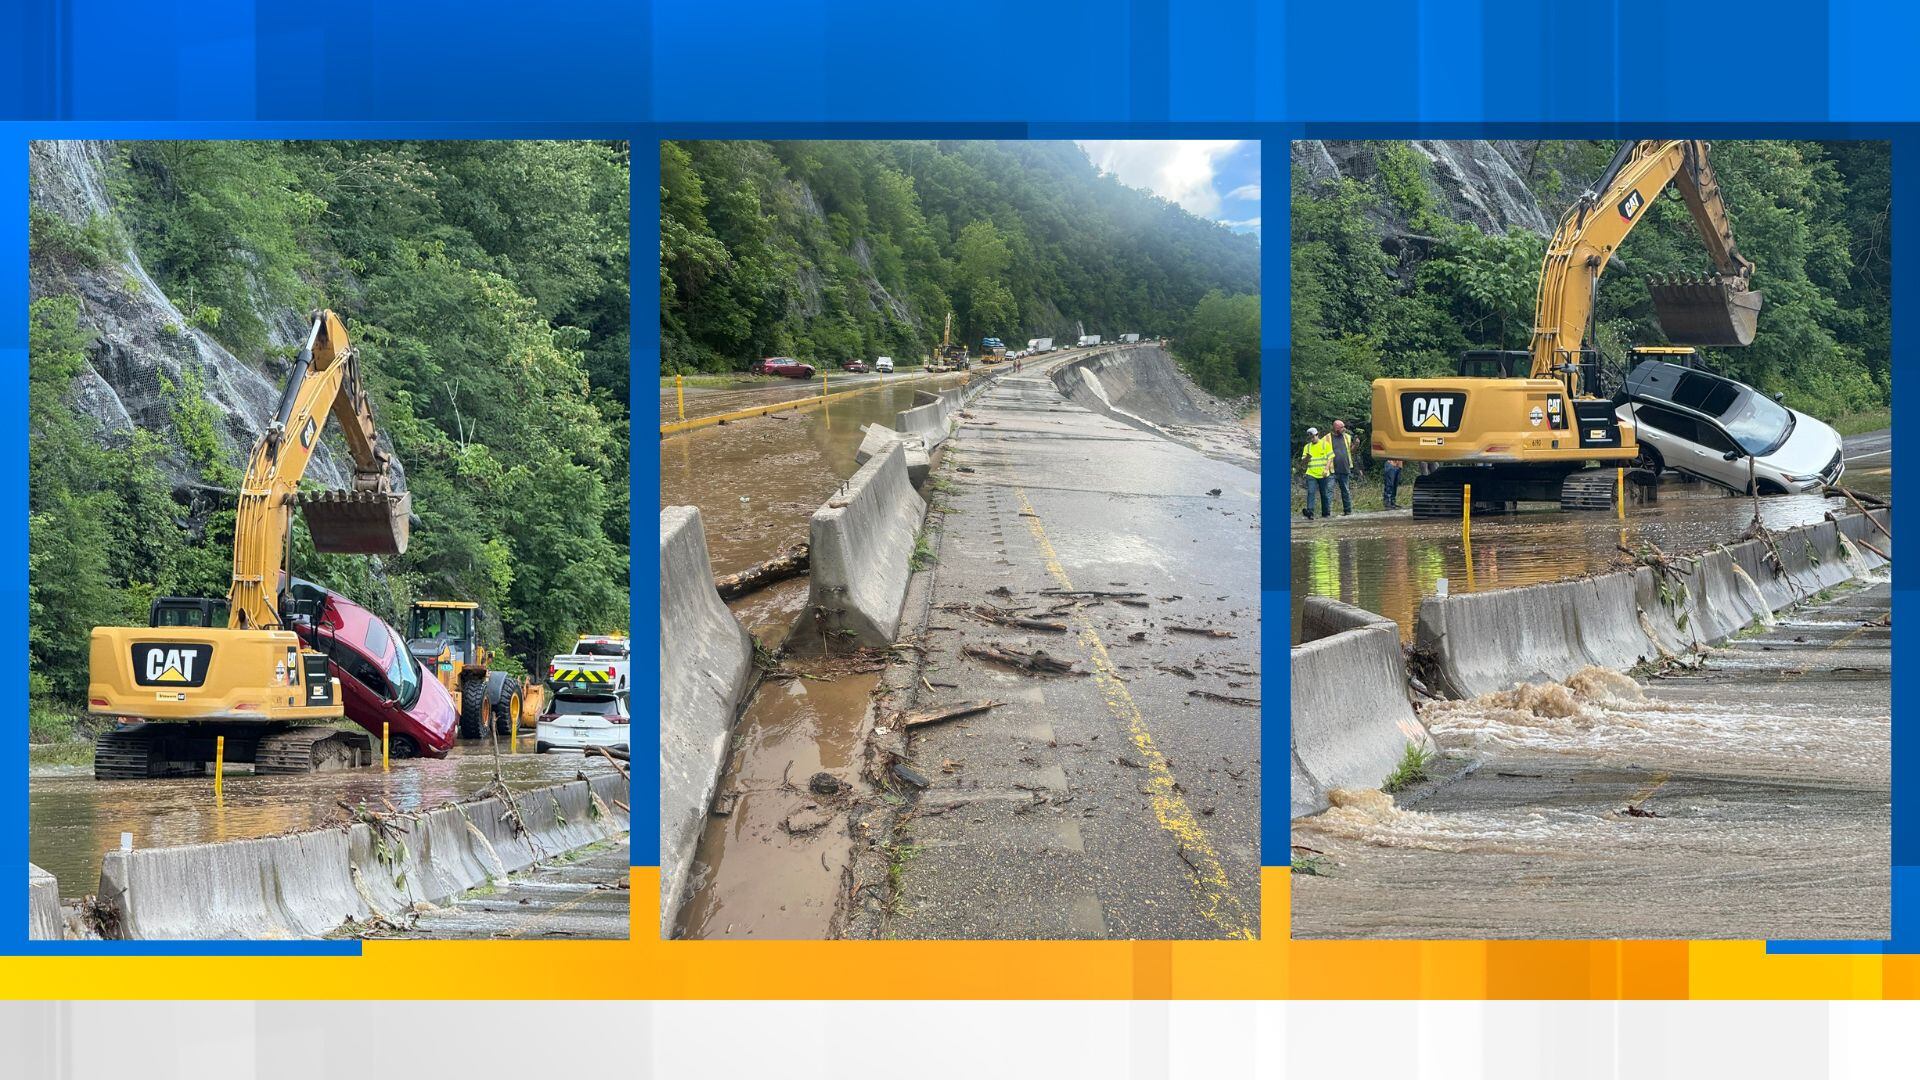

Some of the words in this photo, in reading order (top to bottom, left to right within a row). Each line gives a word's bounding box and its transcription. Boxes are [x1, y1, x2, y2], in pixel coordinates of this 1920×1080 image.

[1412, 397, 1454, 428] CAT
[1547, 398, 1561, 413] CAT
[146, 648, 198, 682] CAT
